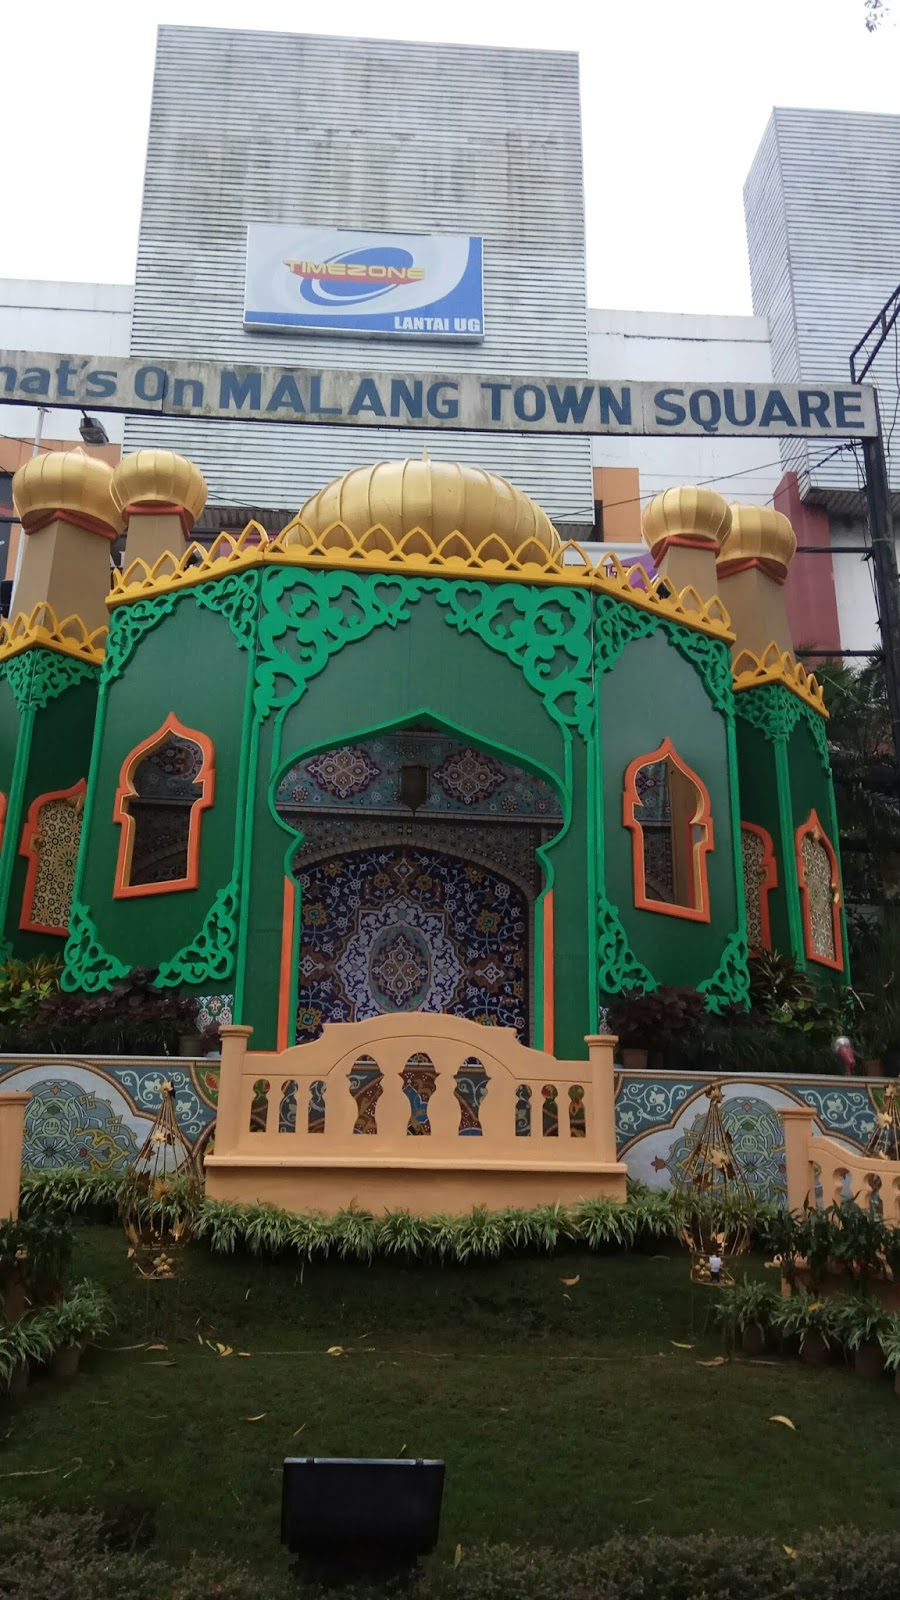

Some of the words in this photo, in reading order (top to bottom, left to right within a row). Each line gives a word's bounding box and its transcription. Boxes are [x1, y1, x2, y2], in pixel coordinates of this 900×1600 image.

[283, 260, 425, 281] TIMEZONE
[394, 316, 449, 332] LANTAI
[454, 317, 481, 333] UG
[133, 365, 205, 408] On
[218, 368, 459, 420] MALANG
[480, 382, 632, 426] TOWN
[654, 387, 866, 432] SQUARE
